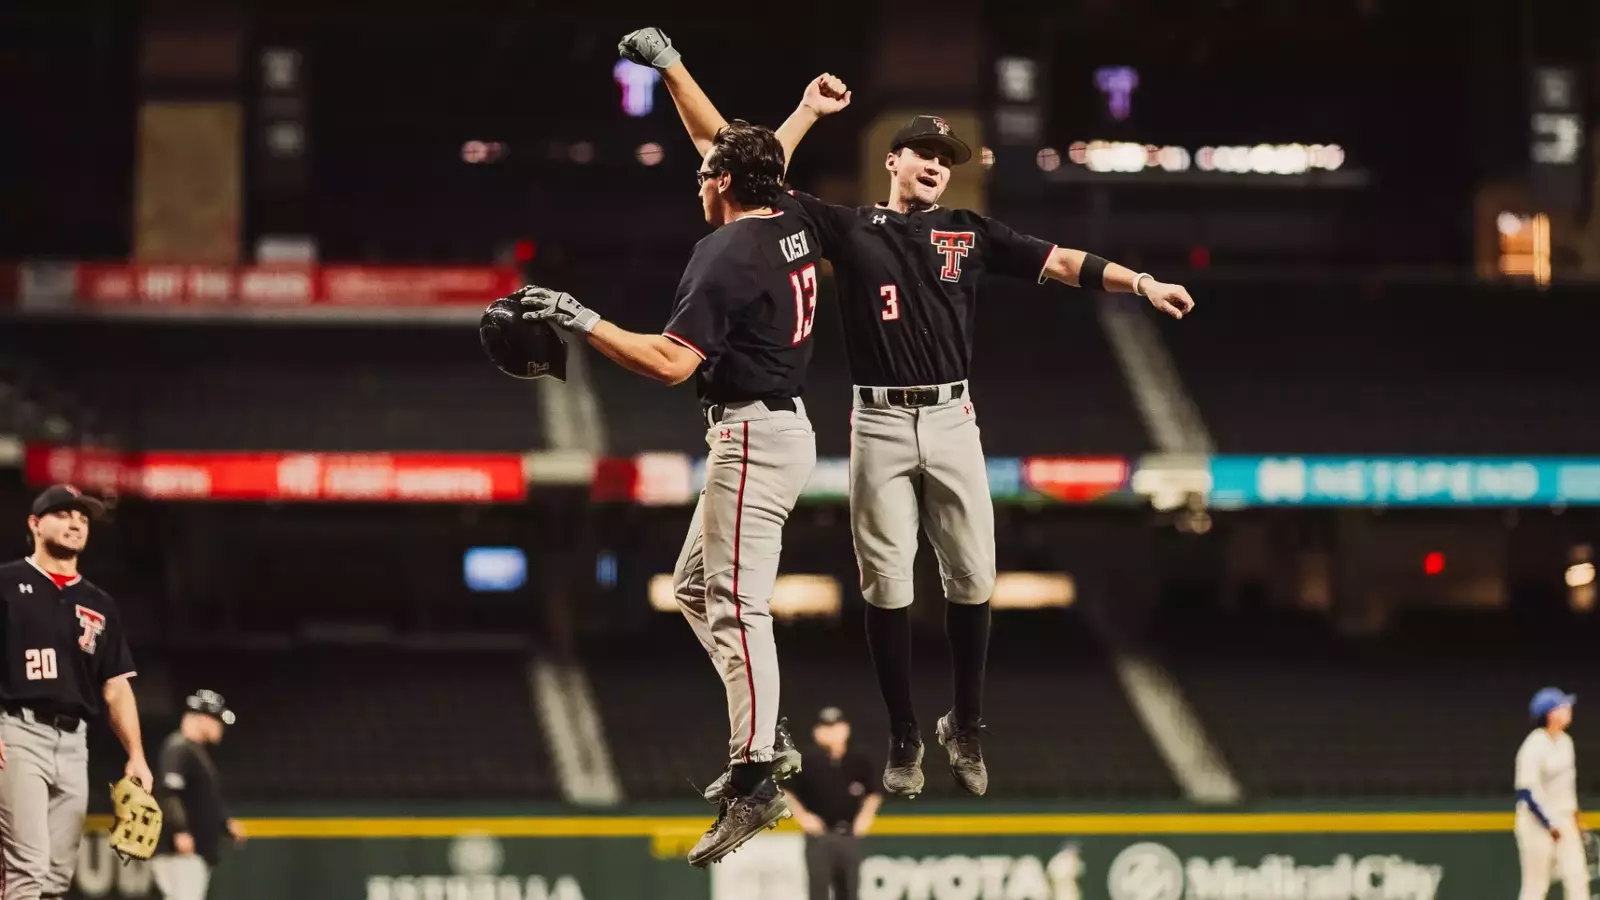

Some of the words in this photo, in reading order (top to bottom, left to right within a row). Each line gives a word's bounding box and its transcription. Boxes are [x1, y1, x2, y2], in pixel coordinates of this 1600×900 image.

[779, 230, 810, 263] KASH
[789, 262, 817, 346] 13
[880, 284, 901, 321] 3
[25, 648, 58, 681] 20
[858, 855, 1050, 900] OYOTA
